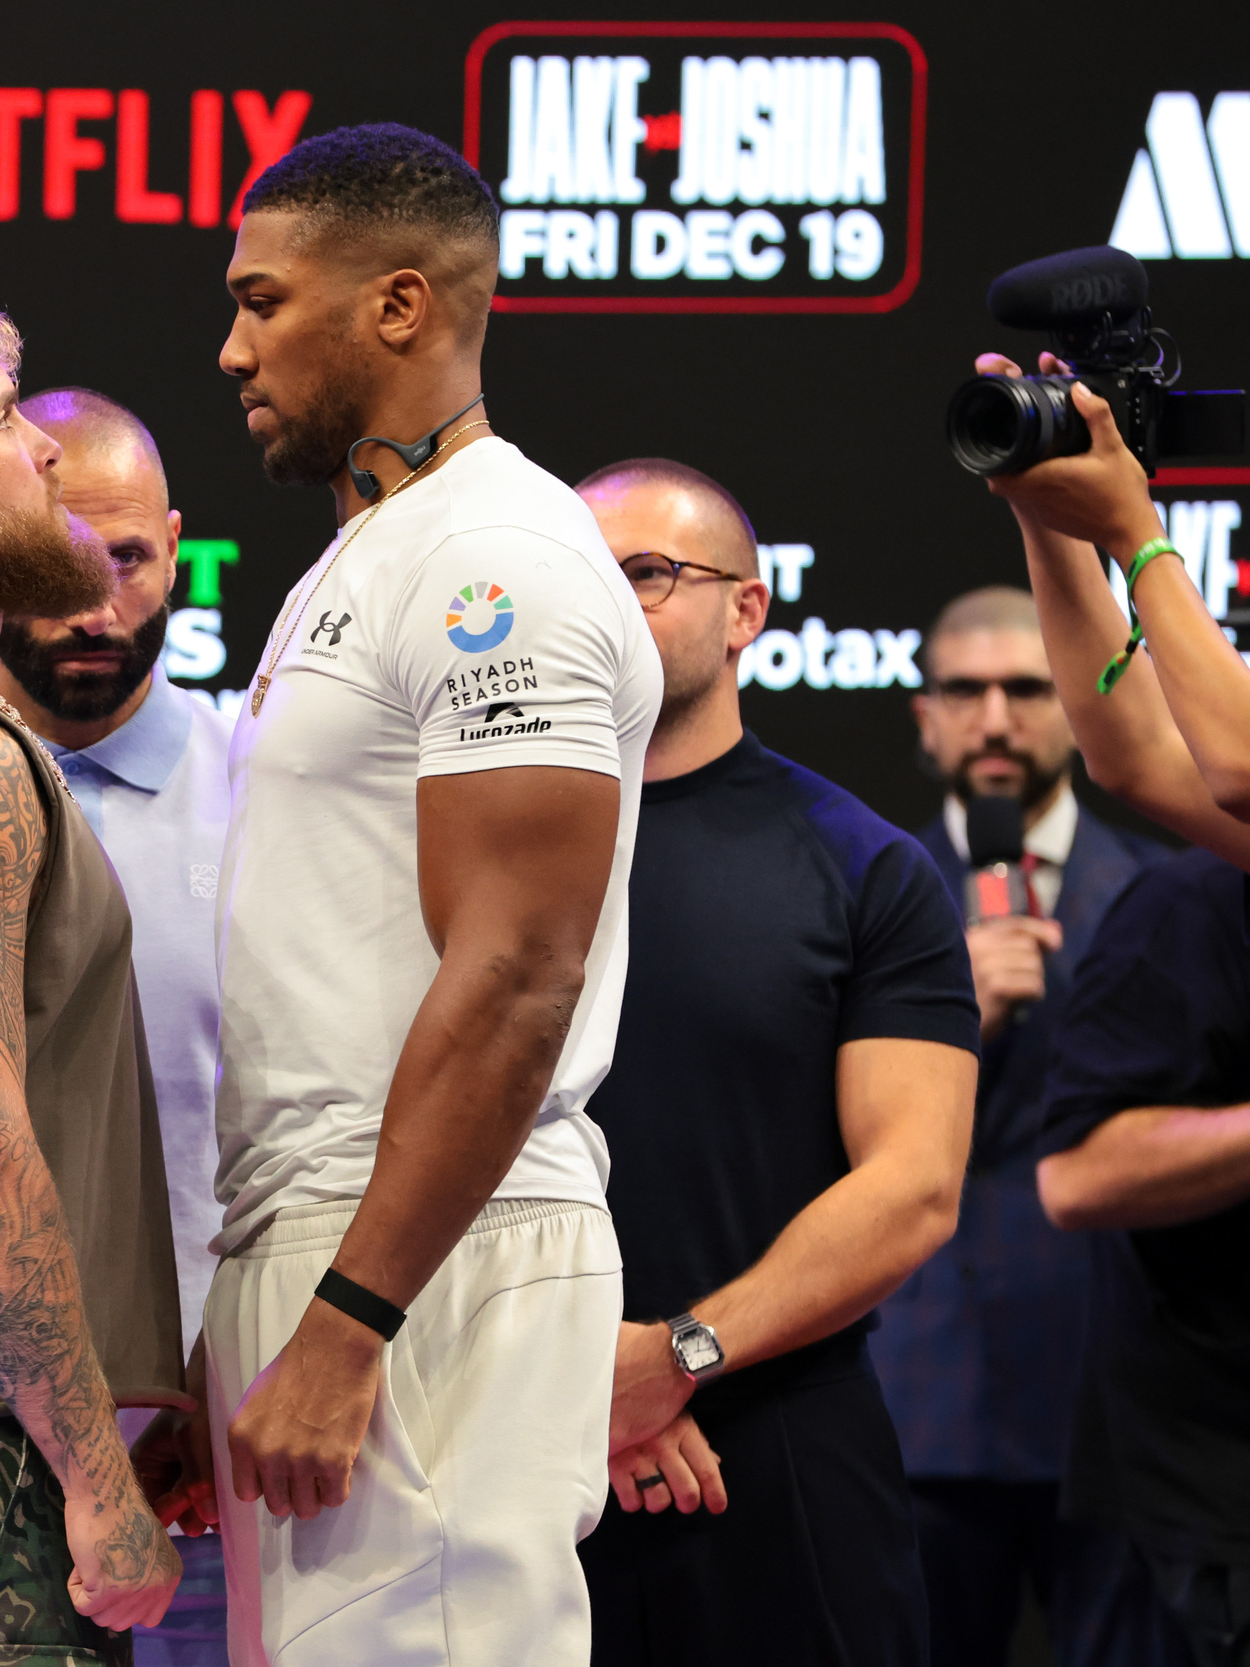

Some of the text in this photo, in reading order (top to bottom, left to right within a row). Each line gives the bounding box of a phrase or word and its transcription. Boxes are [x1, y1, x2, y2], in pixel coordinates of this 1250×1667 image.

[500, 55, 886, 205] JAKE JOSHUA
[498, 209, 884, 280] FRI DEC 19
[447, 657, 534, 693] RIYADH
[451, 675, 538, 711] SEASON
